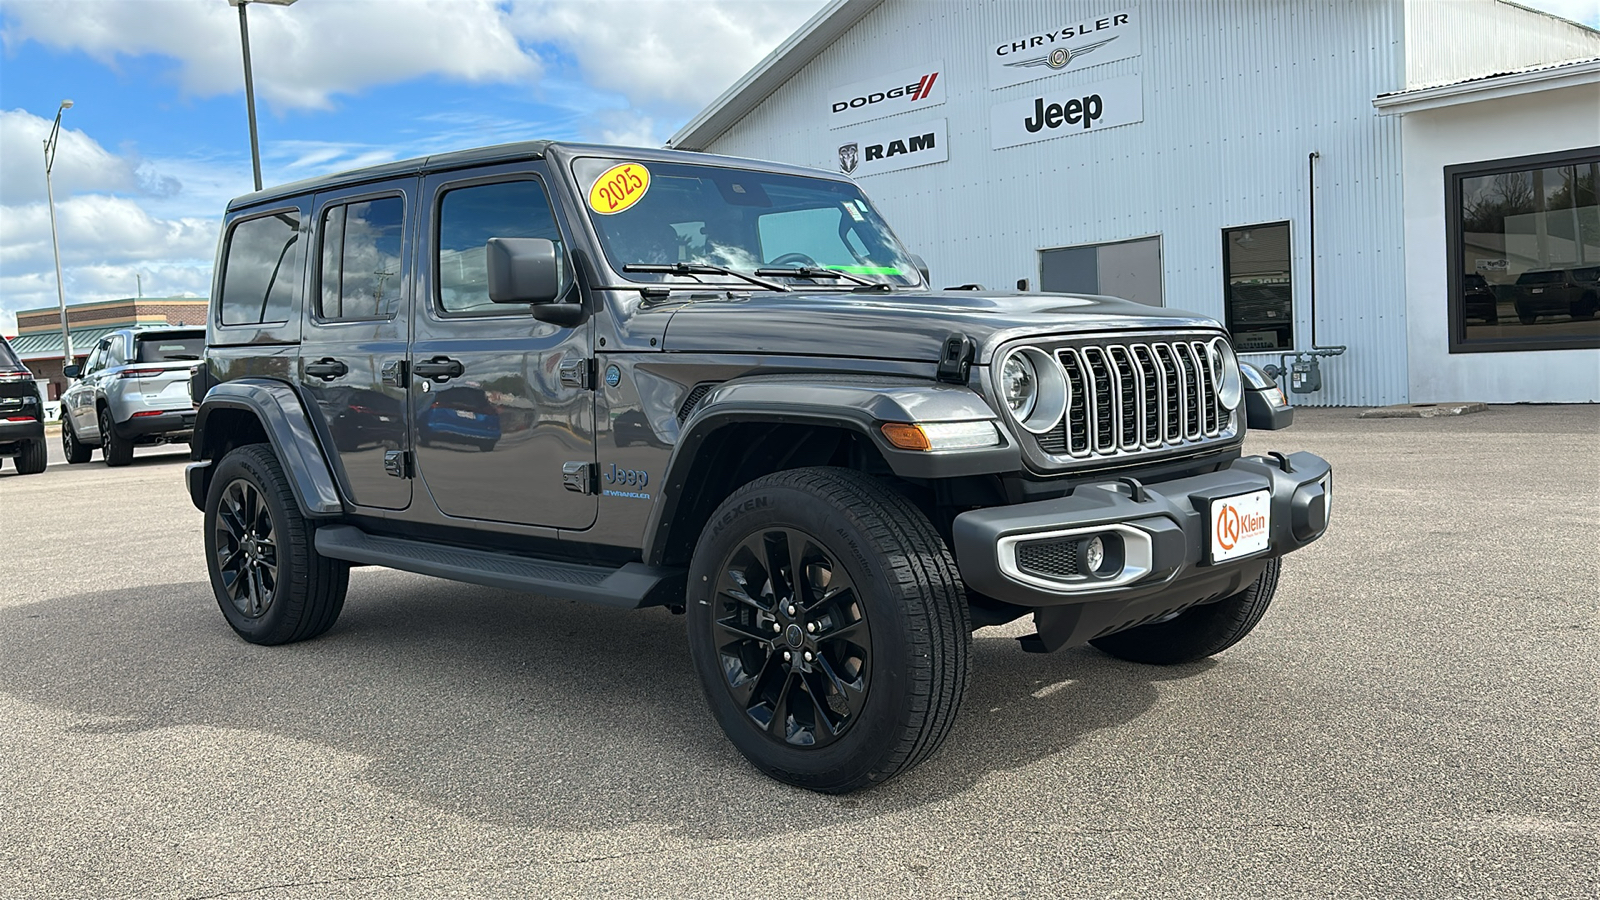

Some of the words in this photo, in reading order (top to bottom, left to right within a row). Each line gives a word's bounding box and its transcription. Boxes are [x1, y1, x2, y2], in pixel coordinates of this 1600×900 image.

[996, 13, 1129, 57] CHRYSLER
[832, 82, 922, 113] DODGE
[1025, 93, 1103, 133] Jeep
[865, 132, 936, 161] RAM
[599, 167, 642, 209] 2025
[604, 463, 648, 490] Jeep
[610, 490, 650, 499] WRANGLER
[712, 496, 768, 537] NEXEN
[1241, 511, 1265, 534] Klein
